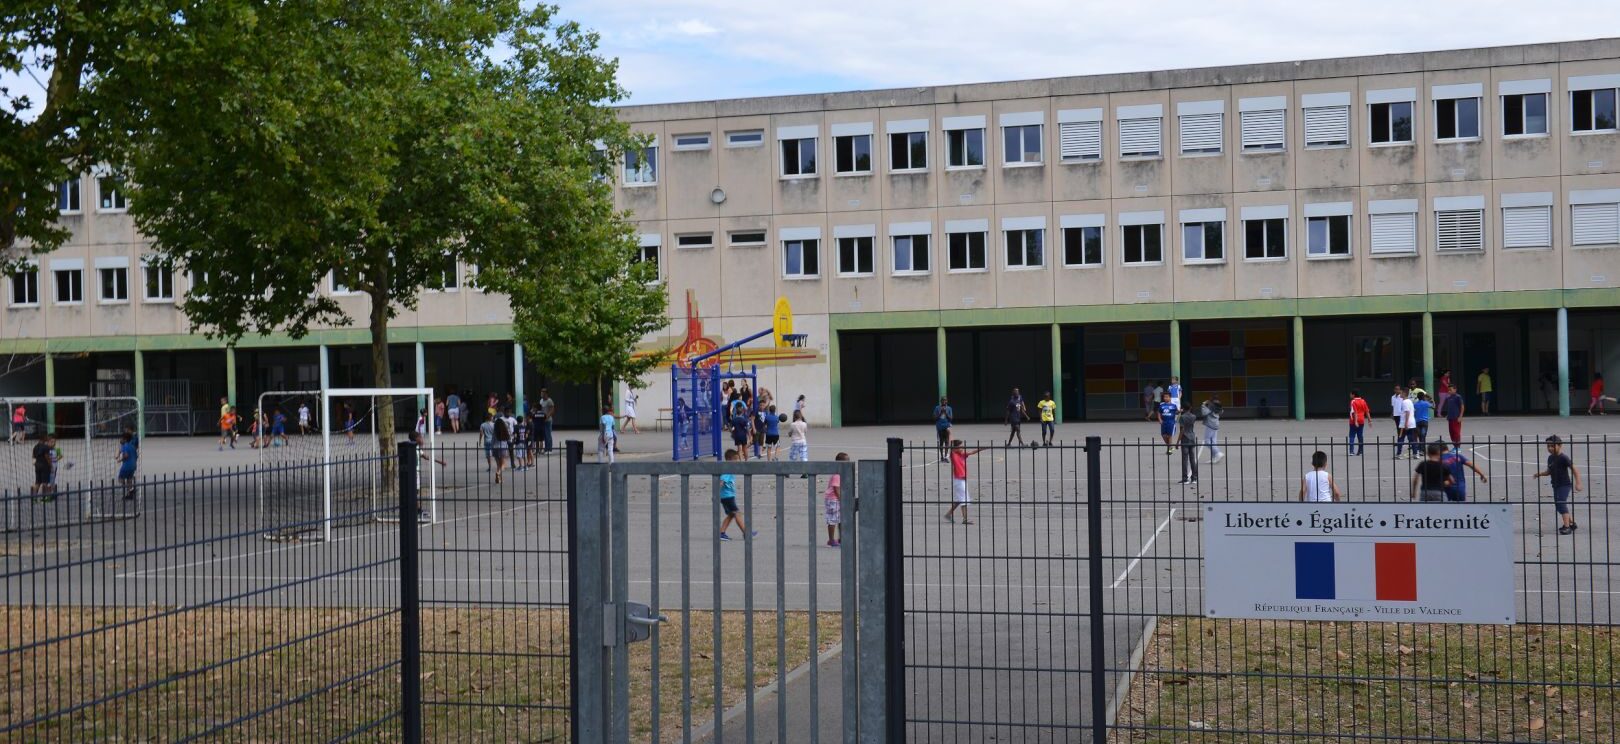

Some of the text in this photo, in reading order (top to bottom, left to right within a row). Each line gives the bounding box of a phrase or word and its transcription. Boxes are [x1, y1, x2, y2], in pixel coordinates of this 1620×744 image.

[1225, 513, 1291, 529] Liberté
[1310, 510, 1374, 533] Égalité
[1394, 513, 1490, 530] Fraternité
[1255, 602, 1312, 613] RÉPUBLIQUE
[1314, 605, 1364, 615] FRANÇAISE
[1374, 605, 1400, 614] VILLE
[1403, 607, 1417, 615] DE
[1419, 606, 1462, 616] VALENCE
